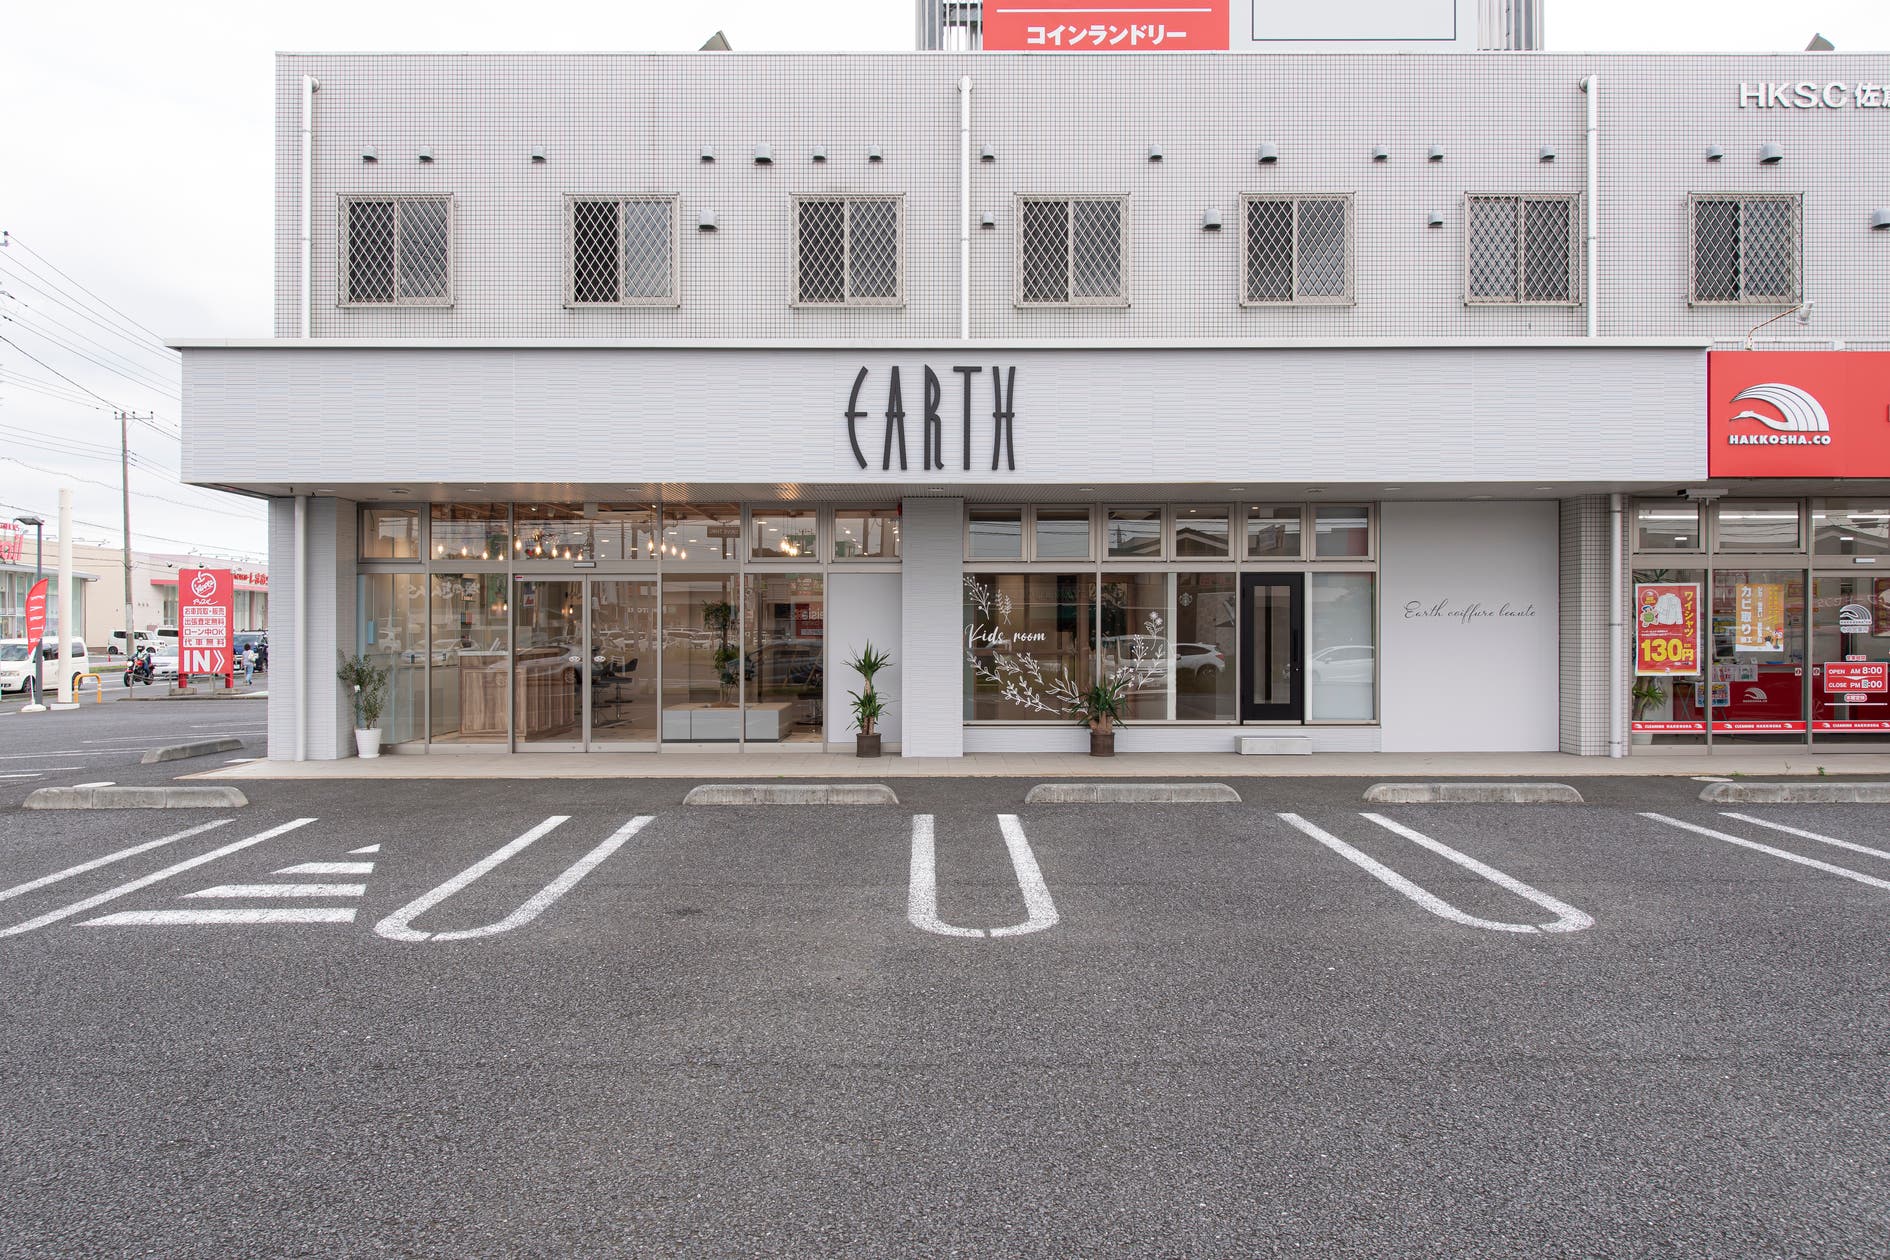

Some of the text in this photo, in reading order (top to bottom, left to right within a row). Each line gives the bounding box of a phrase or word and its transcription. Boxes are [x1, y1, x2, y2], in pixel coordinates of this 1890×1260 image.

[1026, 24, 1187, 45] コインランドリー
[1739, 82, 1847, 108] HKS.C
[844, 364, 1016, 470] EARTH
[1728, 434, 1831, 445] HAKKOSHA.CO
[1403, 598, 1449, 618] Earth
[1684, 591, 1695, 637] ワイシャツ
[184, 617, 225, 626] 出張査定無料
[184, 628, 225, 636] ローン中OK
[964, 624, 1046, 649] Kids room
[183, 649, 210, 672] IN
